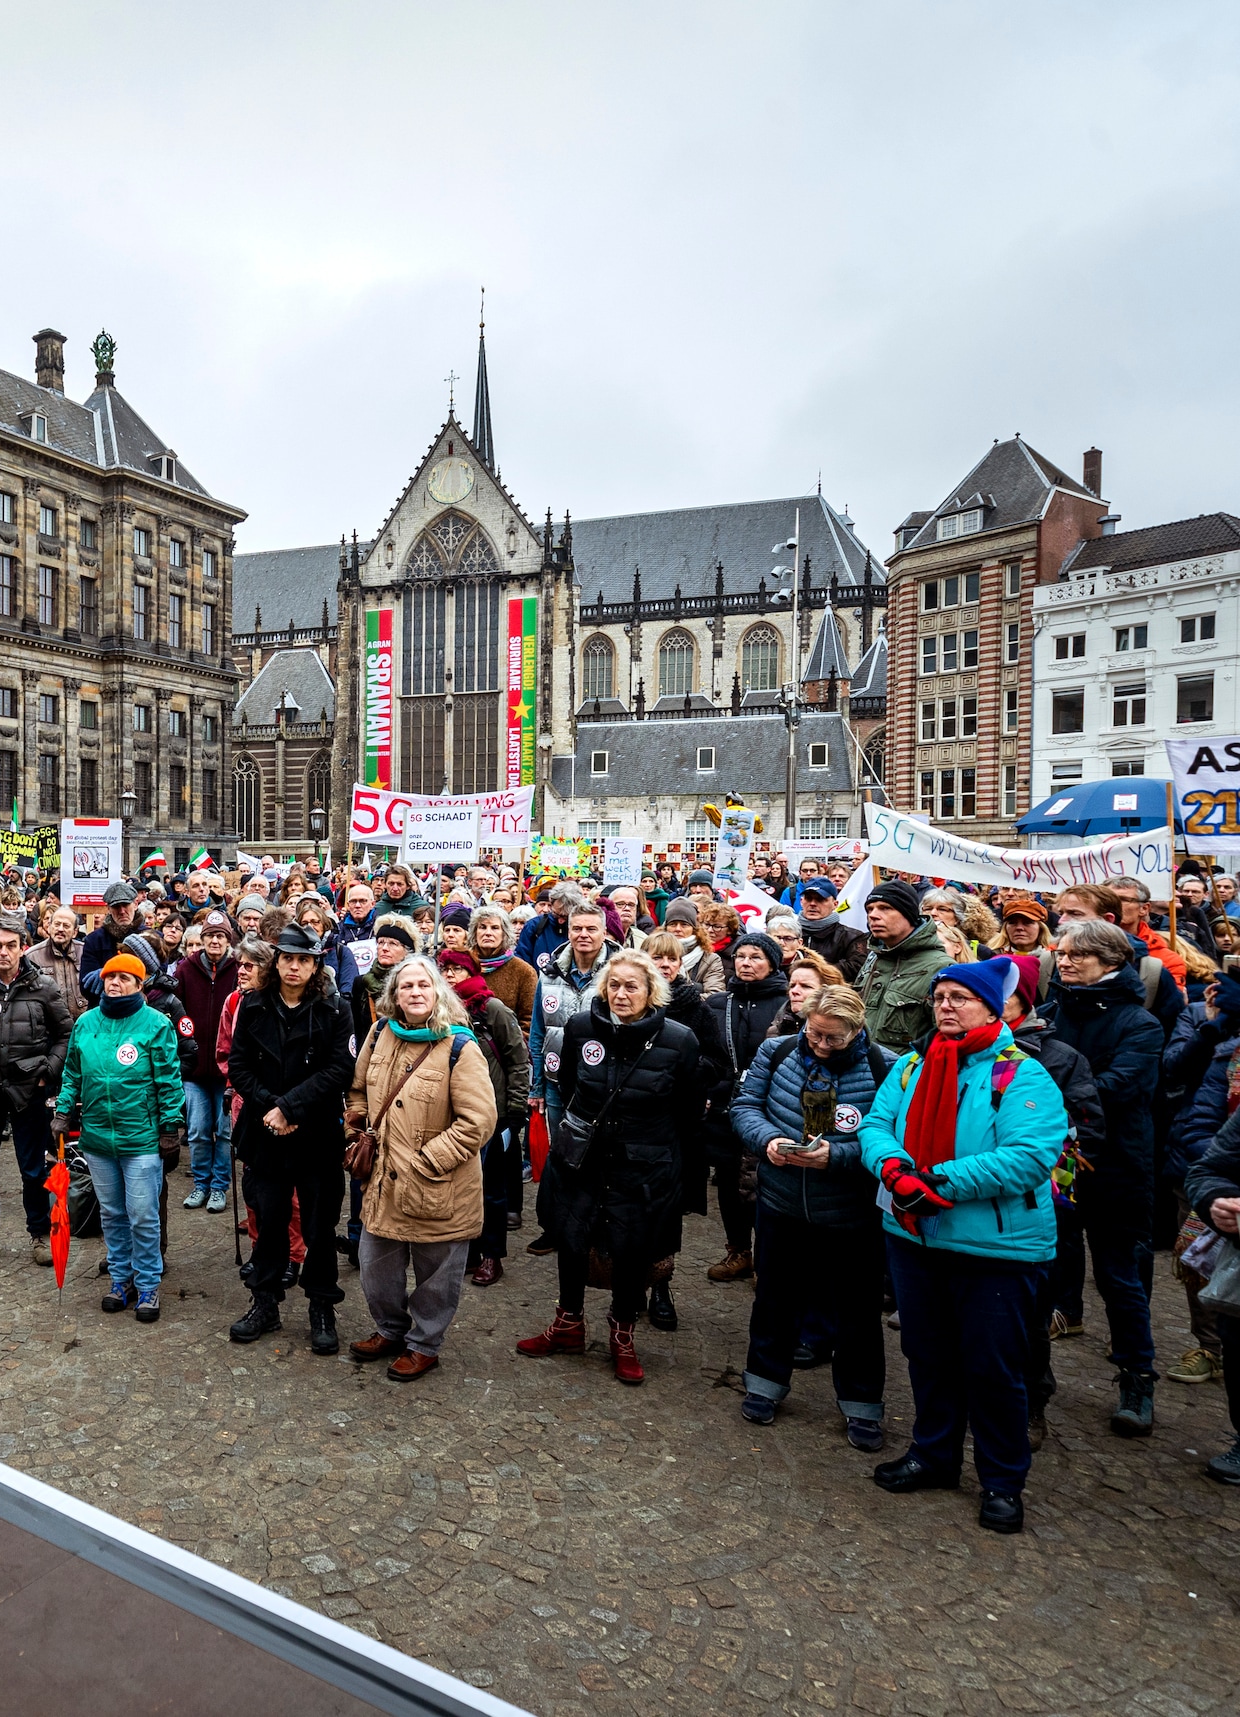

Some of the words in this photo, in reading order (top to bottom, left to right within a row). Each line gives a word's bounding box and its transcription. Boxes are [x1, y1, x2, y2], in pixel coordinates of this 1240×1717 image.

[373, 640, 391, 648] GRAN
[509, 636, 522, 691] SURINAME
[523, 634, 535, 691] VERLENGD!
[366, 654, 391, 747] SRANAN
[508, 727, 521, 770] LAATSTE
[522, 732, 534, 765] MAART
[352, 790, 412, 835] 5G
[410, 814, 423, 823] 5G
[425, 812, 473, 822] SCHAADT
[40, 827, 51, 838] 5G
[46, 837, 57, 847] DO
[408, 840, 473, 851] GEZONDHEID
[610, 841, 629, 855] 5G
[43, 846, 57, 856] NOT
[870, 813, 915, 854] 5G
[1000, 842, 1125, 887] WATCHING
[1128, 843, 1173, 875] YOU
[3, 853, 19, 865] ME
[559, 857, 571, 865] NEE
[609, 857, 629, 865] met
[586, 1048, 600, 1058] 5G
[836, 1112, 856, 1125] 5G
